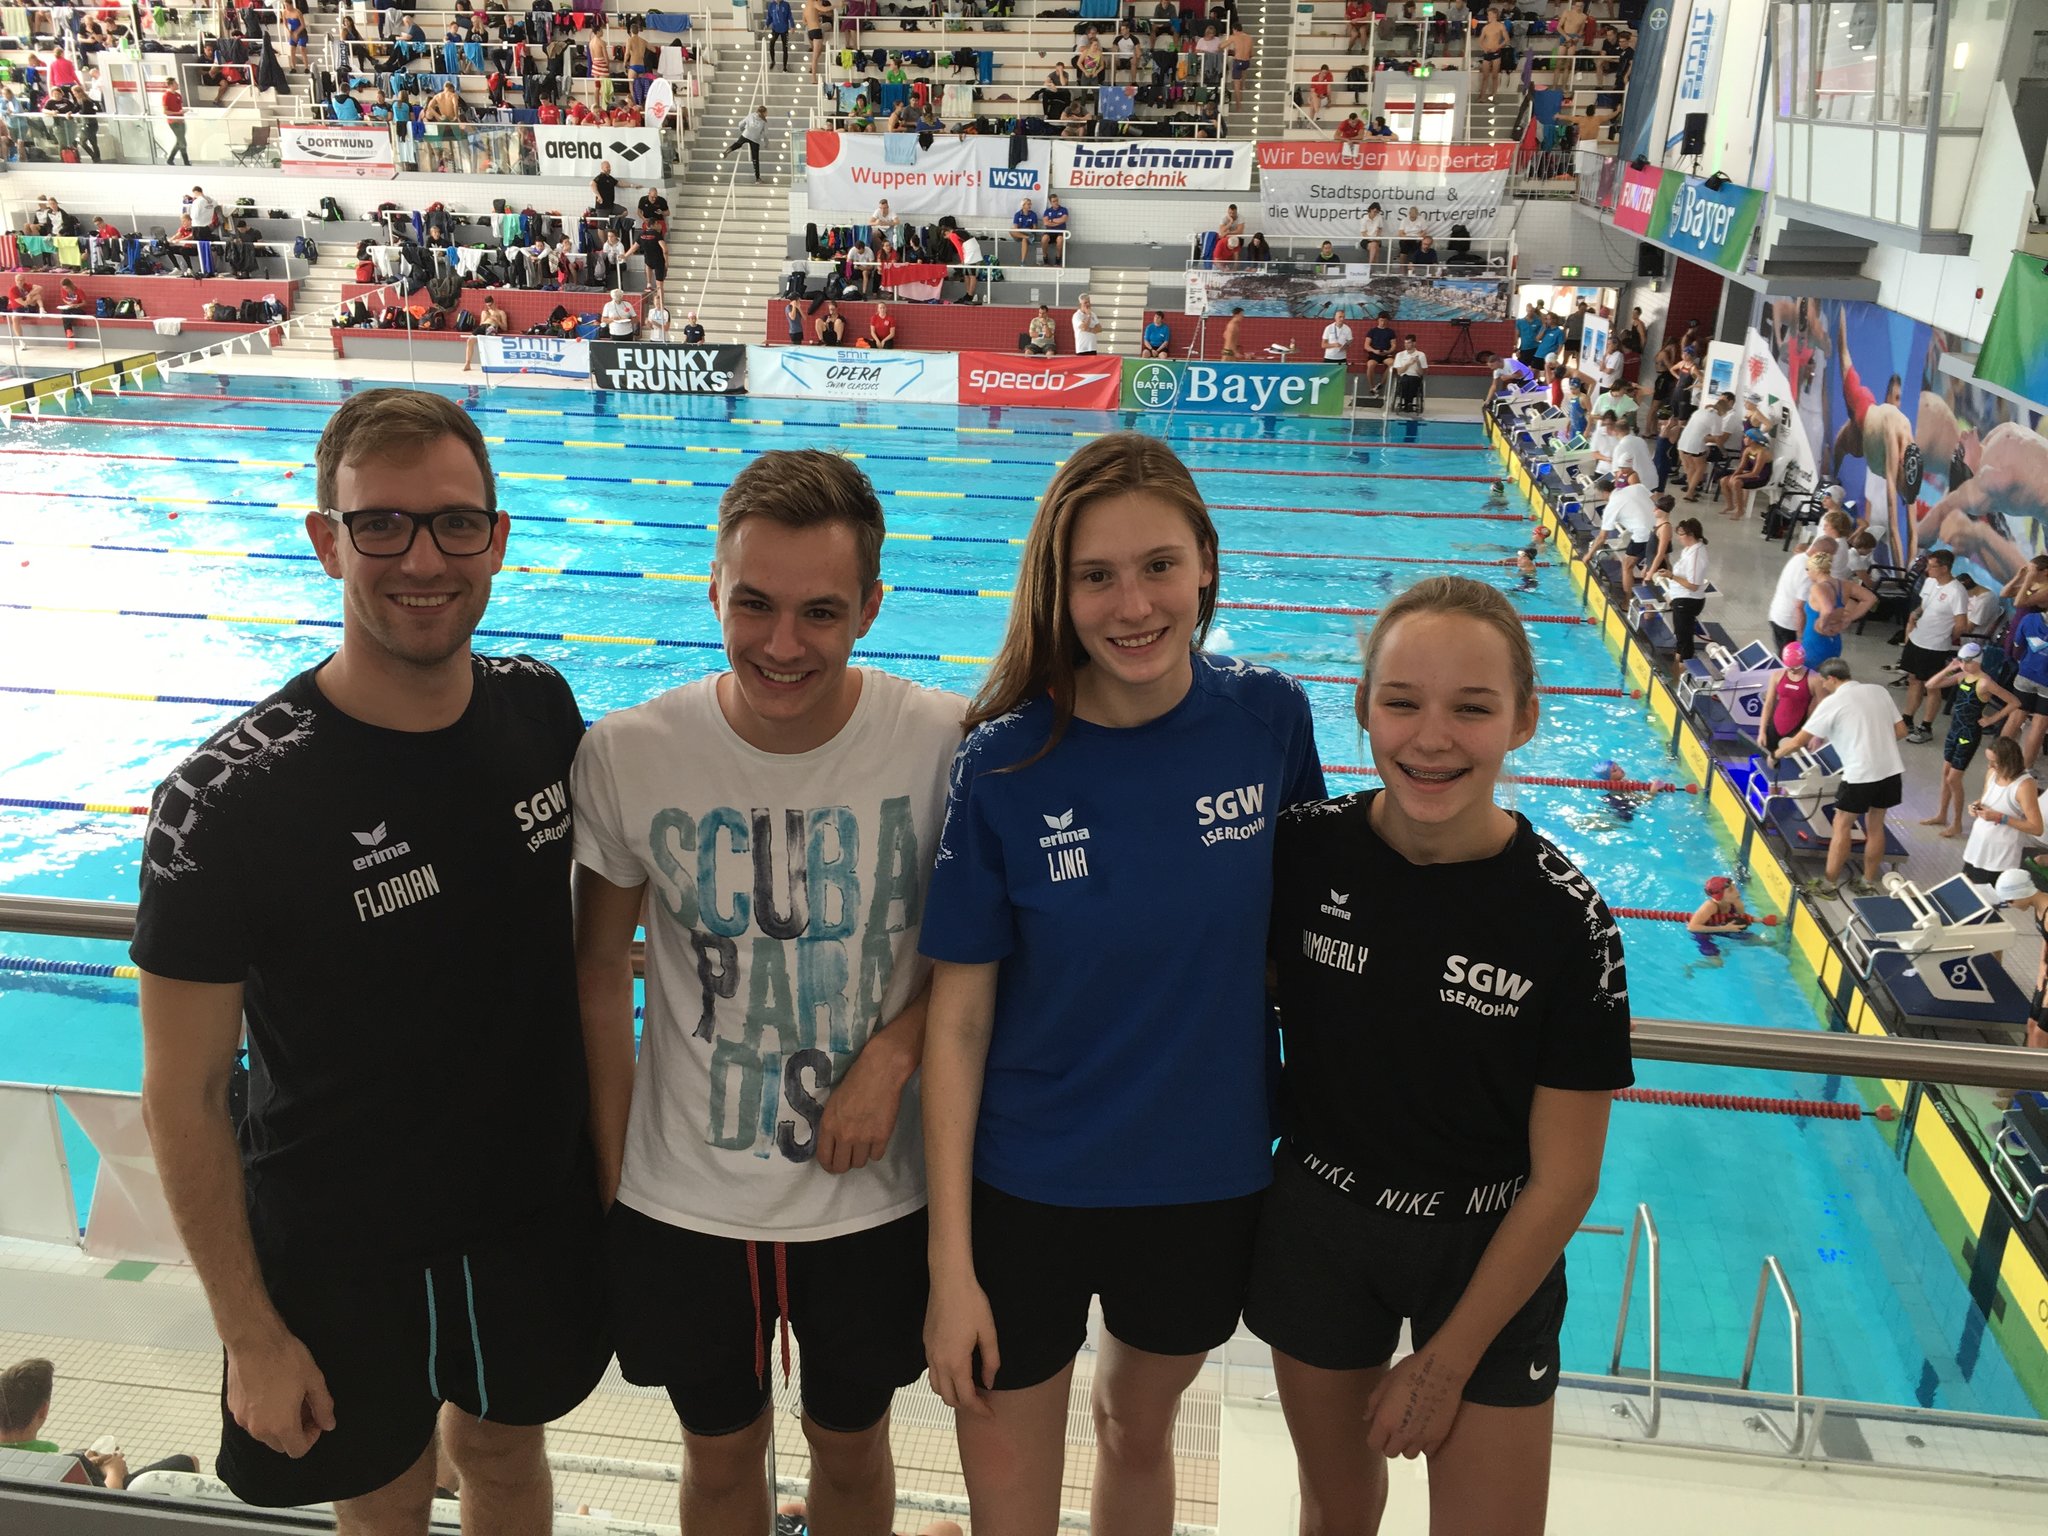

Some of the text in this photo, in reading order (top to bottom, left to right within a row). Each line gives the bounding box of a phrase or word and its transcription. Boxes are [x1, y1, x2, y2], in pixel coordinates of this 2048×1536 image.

[308, 138, 373, 148] DORTMUND
[545, 140, 603, 160] arena
[1073, 144, 1234, 168] hartmann
[1261, 147, 1294, 165] Wir
[1301, 147, 1389, 169] bewegen
[1397, 150, 1498, 171] Wuppertal
[851, 166, 982, 190] Wuppen wir's!
[1070, 170, 1188, 187] Bürotechnik
[1310, 184, 1458, 203] Stadtsportbund &
[1268, 204, 1497, 222] die Wuppertar Sortvereine
[1680, 186, 1736, 249] Bayer
[501, 336, 566, 352] SMIT
[837, 350, 871, 359] SMIT
[616, 348, 719, 371] FUNKY
[826, 365, 882, 381] OPERA
[968, 369, 1066, 393] speedo
[825, 381, 880, 390] SWIM CLASSICS
[1136, 381, 1174, 390] BAYER
[1185, 366, 1330, 411] Bayer
[1746, 698, 1760, 713] 6
[513, 780, 568, 832] SGW
[1195, 783, 1265, 826] SGW
[526, 812, 572, 853] ISERLOHN
[1039, 827, 1090, 848] erima
[1200, 816, 1265, 847] ISERLOHN
[352, 841, 411, 871] erima
[649, 795, 919, 939] SCUBA
[1047, 846, 1089, 882] LINA
[353, 863, 441, 922] FLORIAN
[1320, 903, 1351, 921] erima
[1442, 954, 1534, 1002] SGW
[1950, 964, 1968, 985] 8
[691, 927, 895, 1056] PARA
[1439, 988, 1520, 1018] ISERLOHN
[705, 1034, 846, 1163] DIS
[1303, 1153, 1524, 1216] NIKE NIKE NIKE
